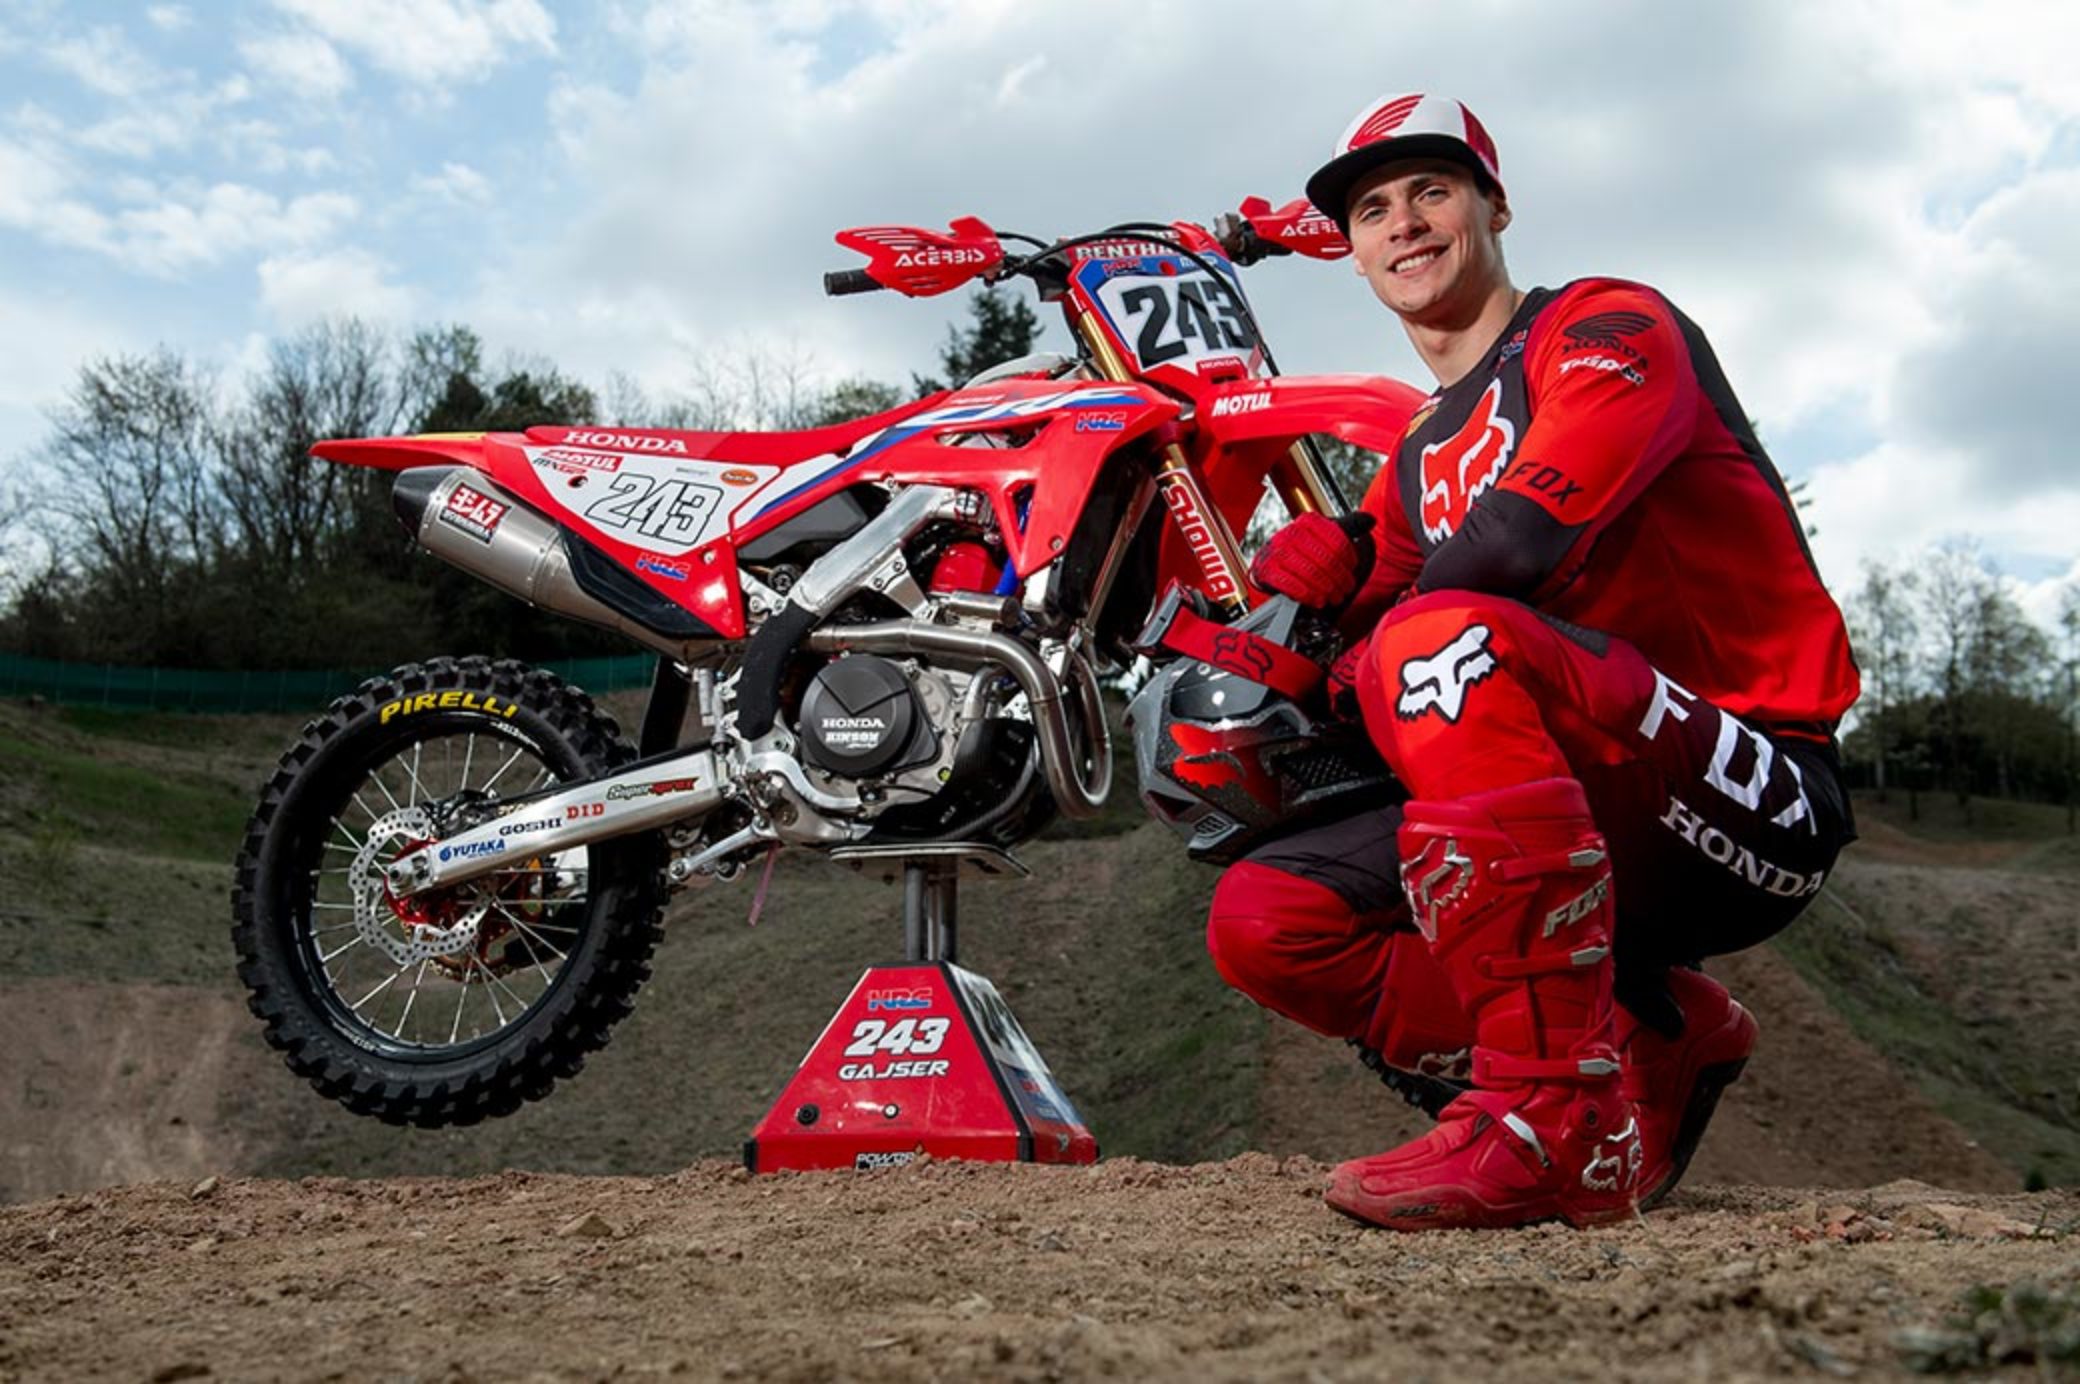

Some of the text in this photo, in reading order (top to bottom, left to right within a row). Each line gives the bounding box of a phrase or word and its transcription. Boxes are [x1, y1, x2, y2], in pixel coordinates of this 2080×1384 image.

[895, 247, 986, 267] ACERBIS
[1121, 280, 1257, 369] 243
[1562, 335, 1648, 371] HONDA
[1211, 392, 1272, 417] MOTUL
[1075, 411, 1127, 432] HRC
[563, 431, 689, 453] HONDA
[1503, 461, 1585, 507] FOX
[584, 472, 724, 547] 243
[1160, 481, 1240, 601] SHOWA
[635, 551, 692, 581] HRC
[380, 690, 518, 725] PIRELLI
[822, 717, 885, 728] HONDA
[1638, 665, 1818, 837] FOX
[499, 817, 562, 836] GOSHI
[453, 838, 506, 857] YUTAKA
[1659, 796, 1824, 898] HONDA
[1541, 871, 1612, 938] FOX
[867, 988, 932, 1011] HRC
[843, 1017, 951, 1057] 243
[838, 1060, 950, 1080] GAJSER
